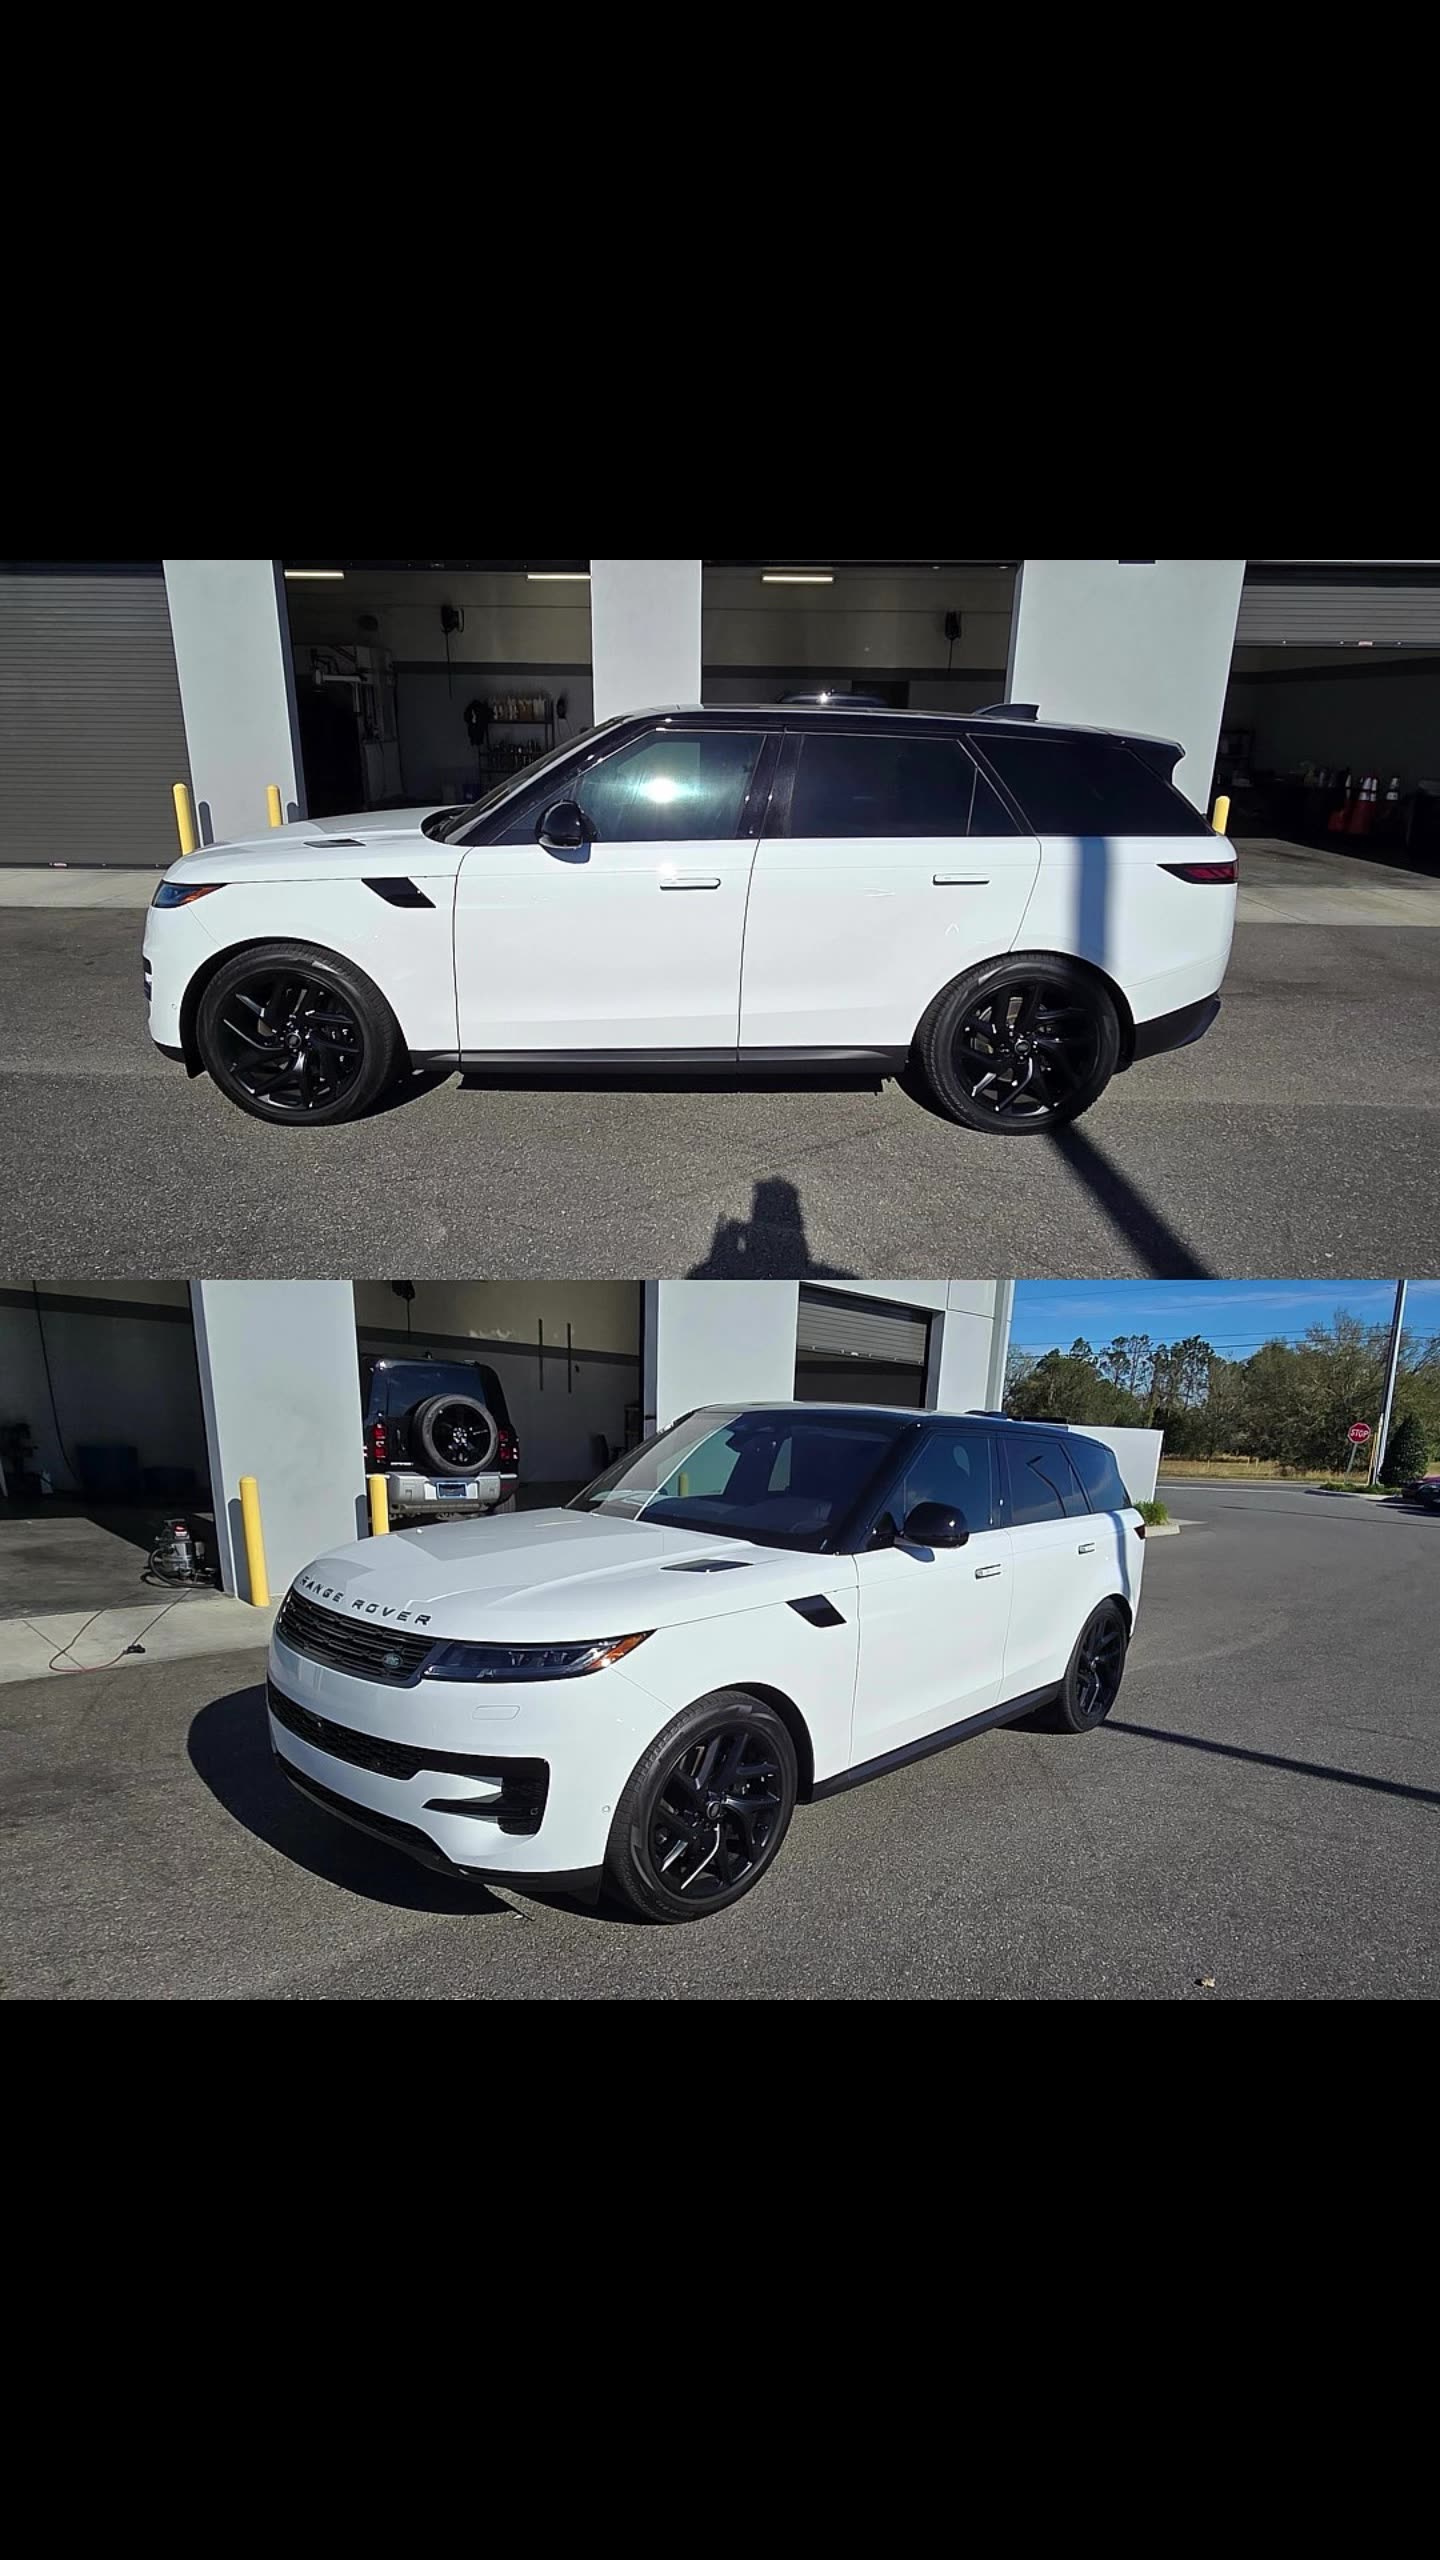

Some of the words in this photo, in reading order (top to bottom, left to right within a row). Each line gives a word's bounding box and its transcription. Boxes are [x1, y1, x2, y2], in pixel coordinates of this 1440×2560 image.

[1350, 1429, 1369, 1438] STOP
[300, 1576, 344, 1603] RANGE
[351, 1599, 432, 1626] ROVER
